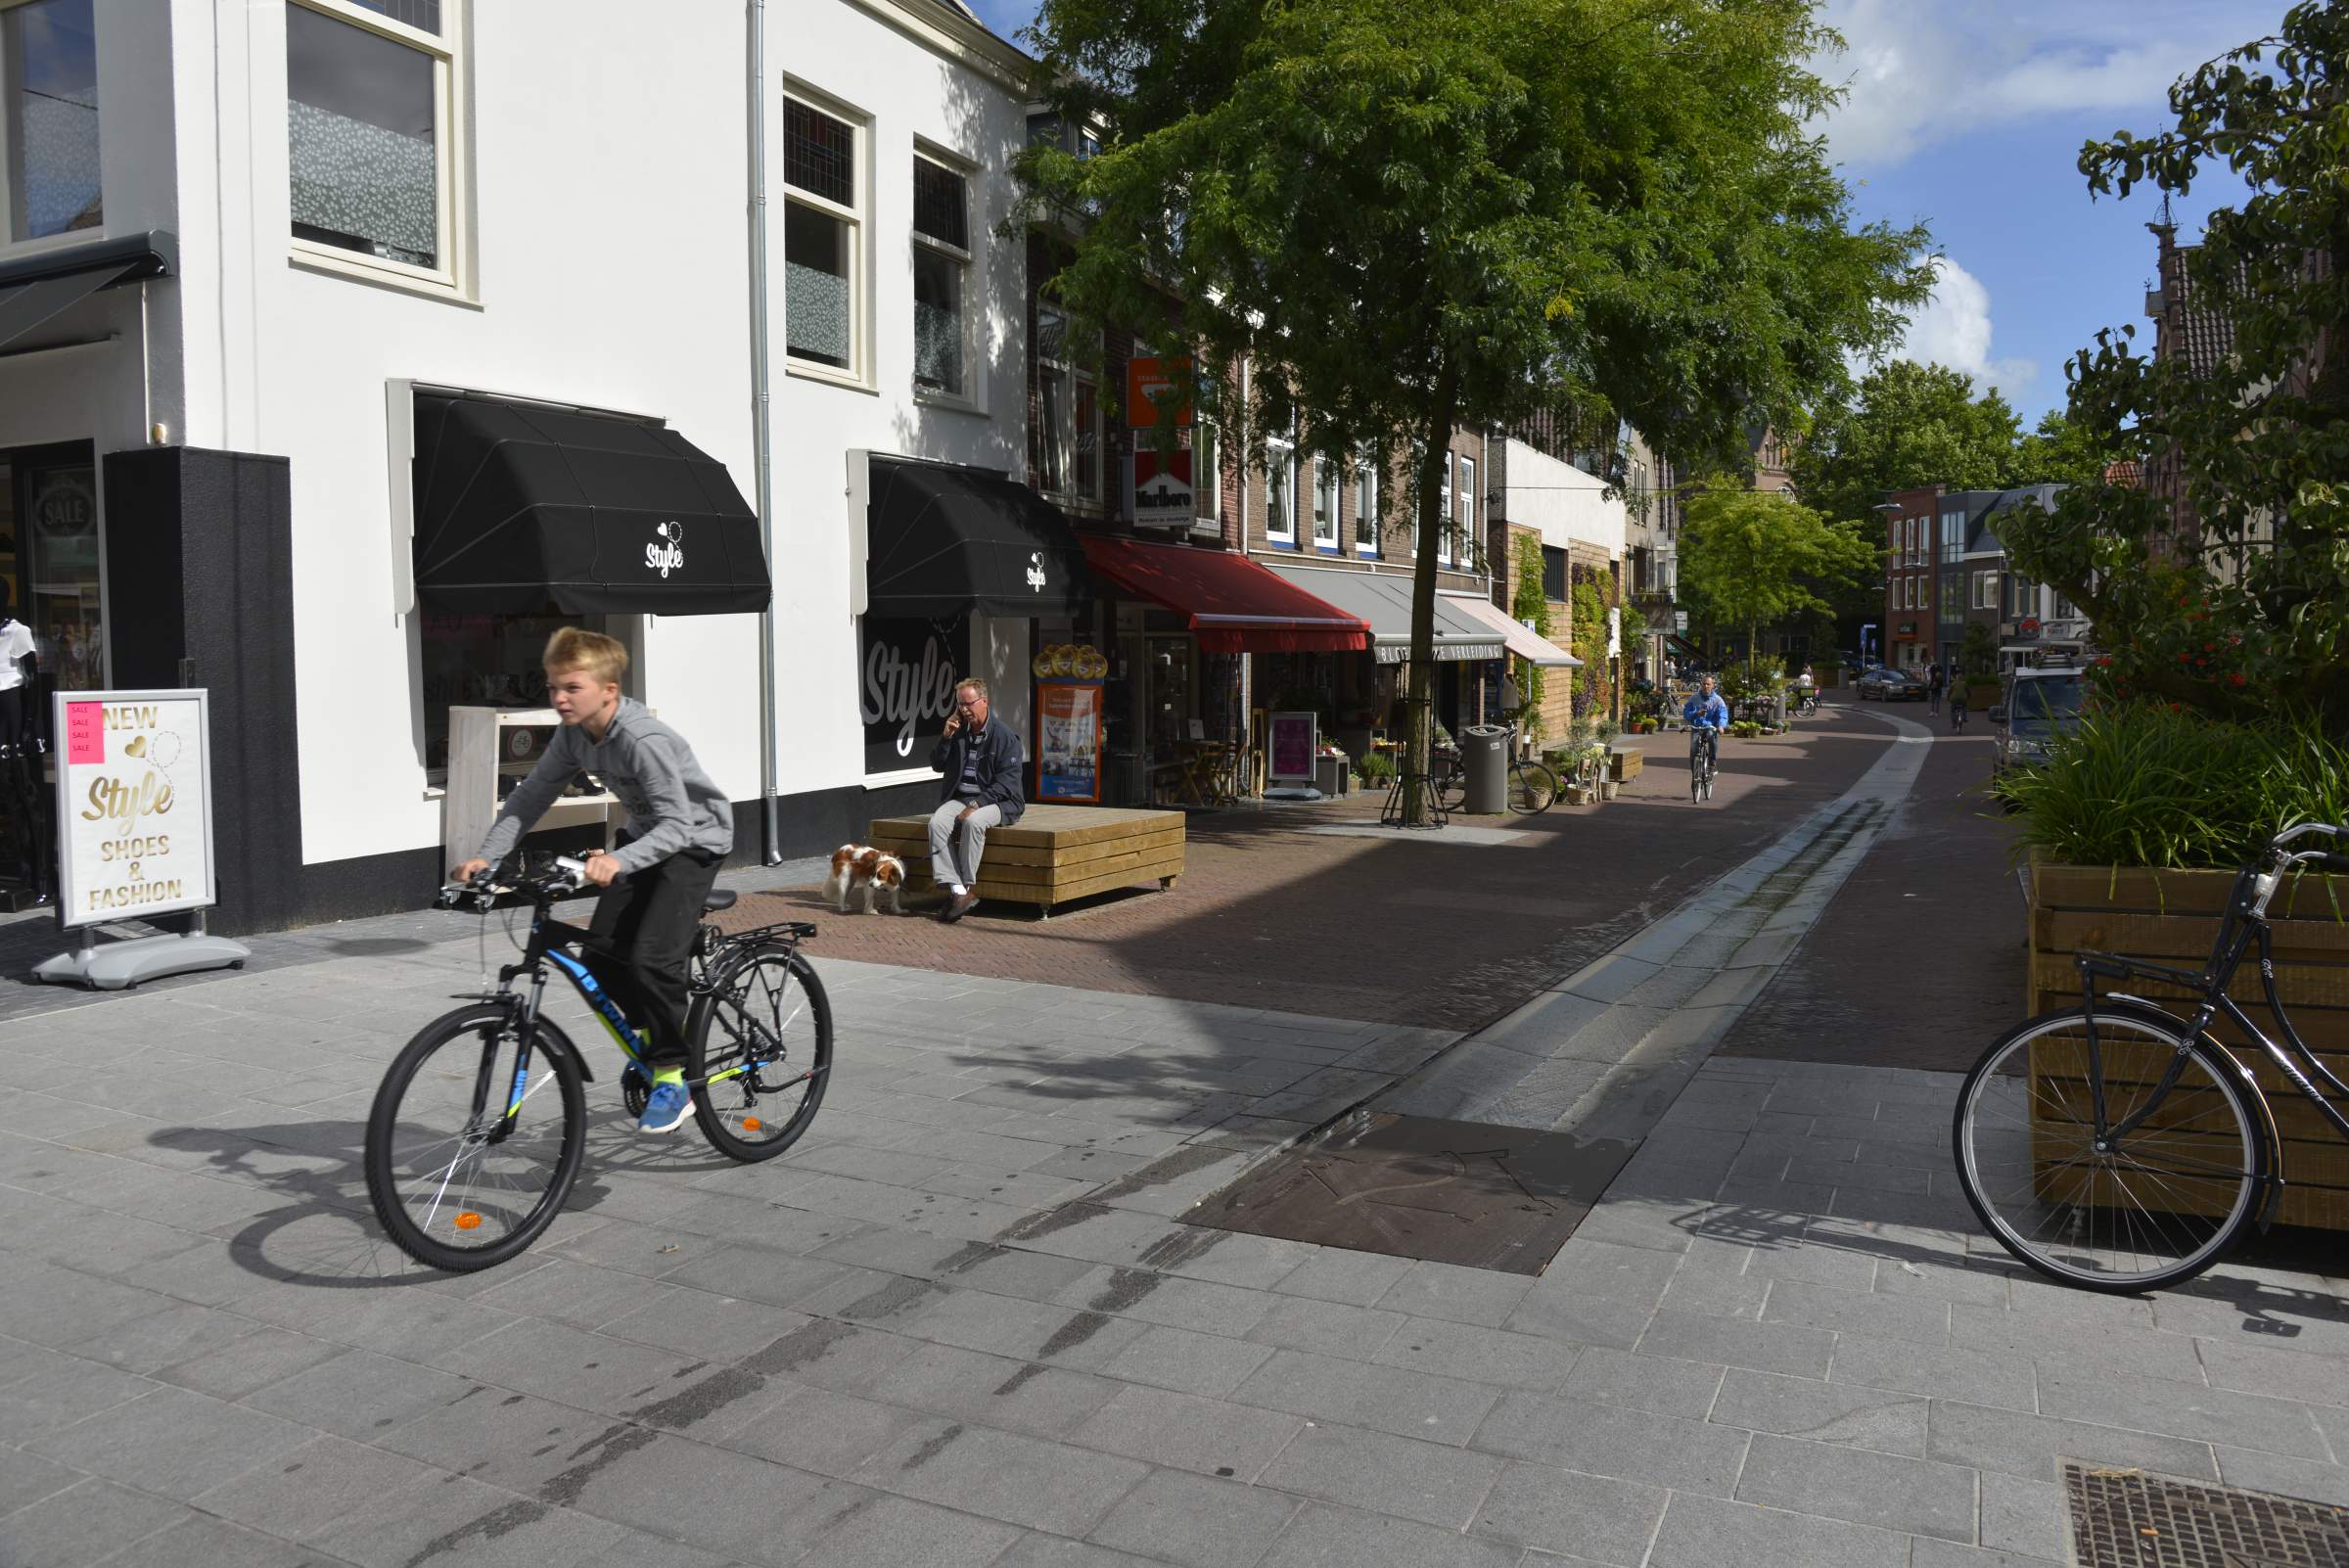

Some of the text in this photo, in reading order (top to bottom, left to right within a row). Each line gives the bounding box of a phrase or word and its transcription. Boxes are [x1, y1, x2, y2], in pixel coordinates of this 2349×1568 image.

[1135, 485, 1190, 507] Marlboro
[44, 500, 84, 526] SALE
[645, 541, 683, 578] Style
[1027, 567, 1046, 593] Style
[1450, 644, 1499, 660] VERLEIDING
[861, 635, 956, 757] Style
[102, 706, 159, 731] NEW
[81, 770, 174, 837] Style
[101, 834, 170, 862] SHOES
[128, 861, 146, 882] &
[89, 879, 182, 911] FASHION
